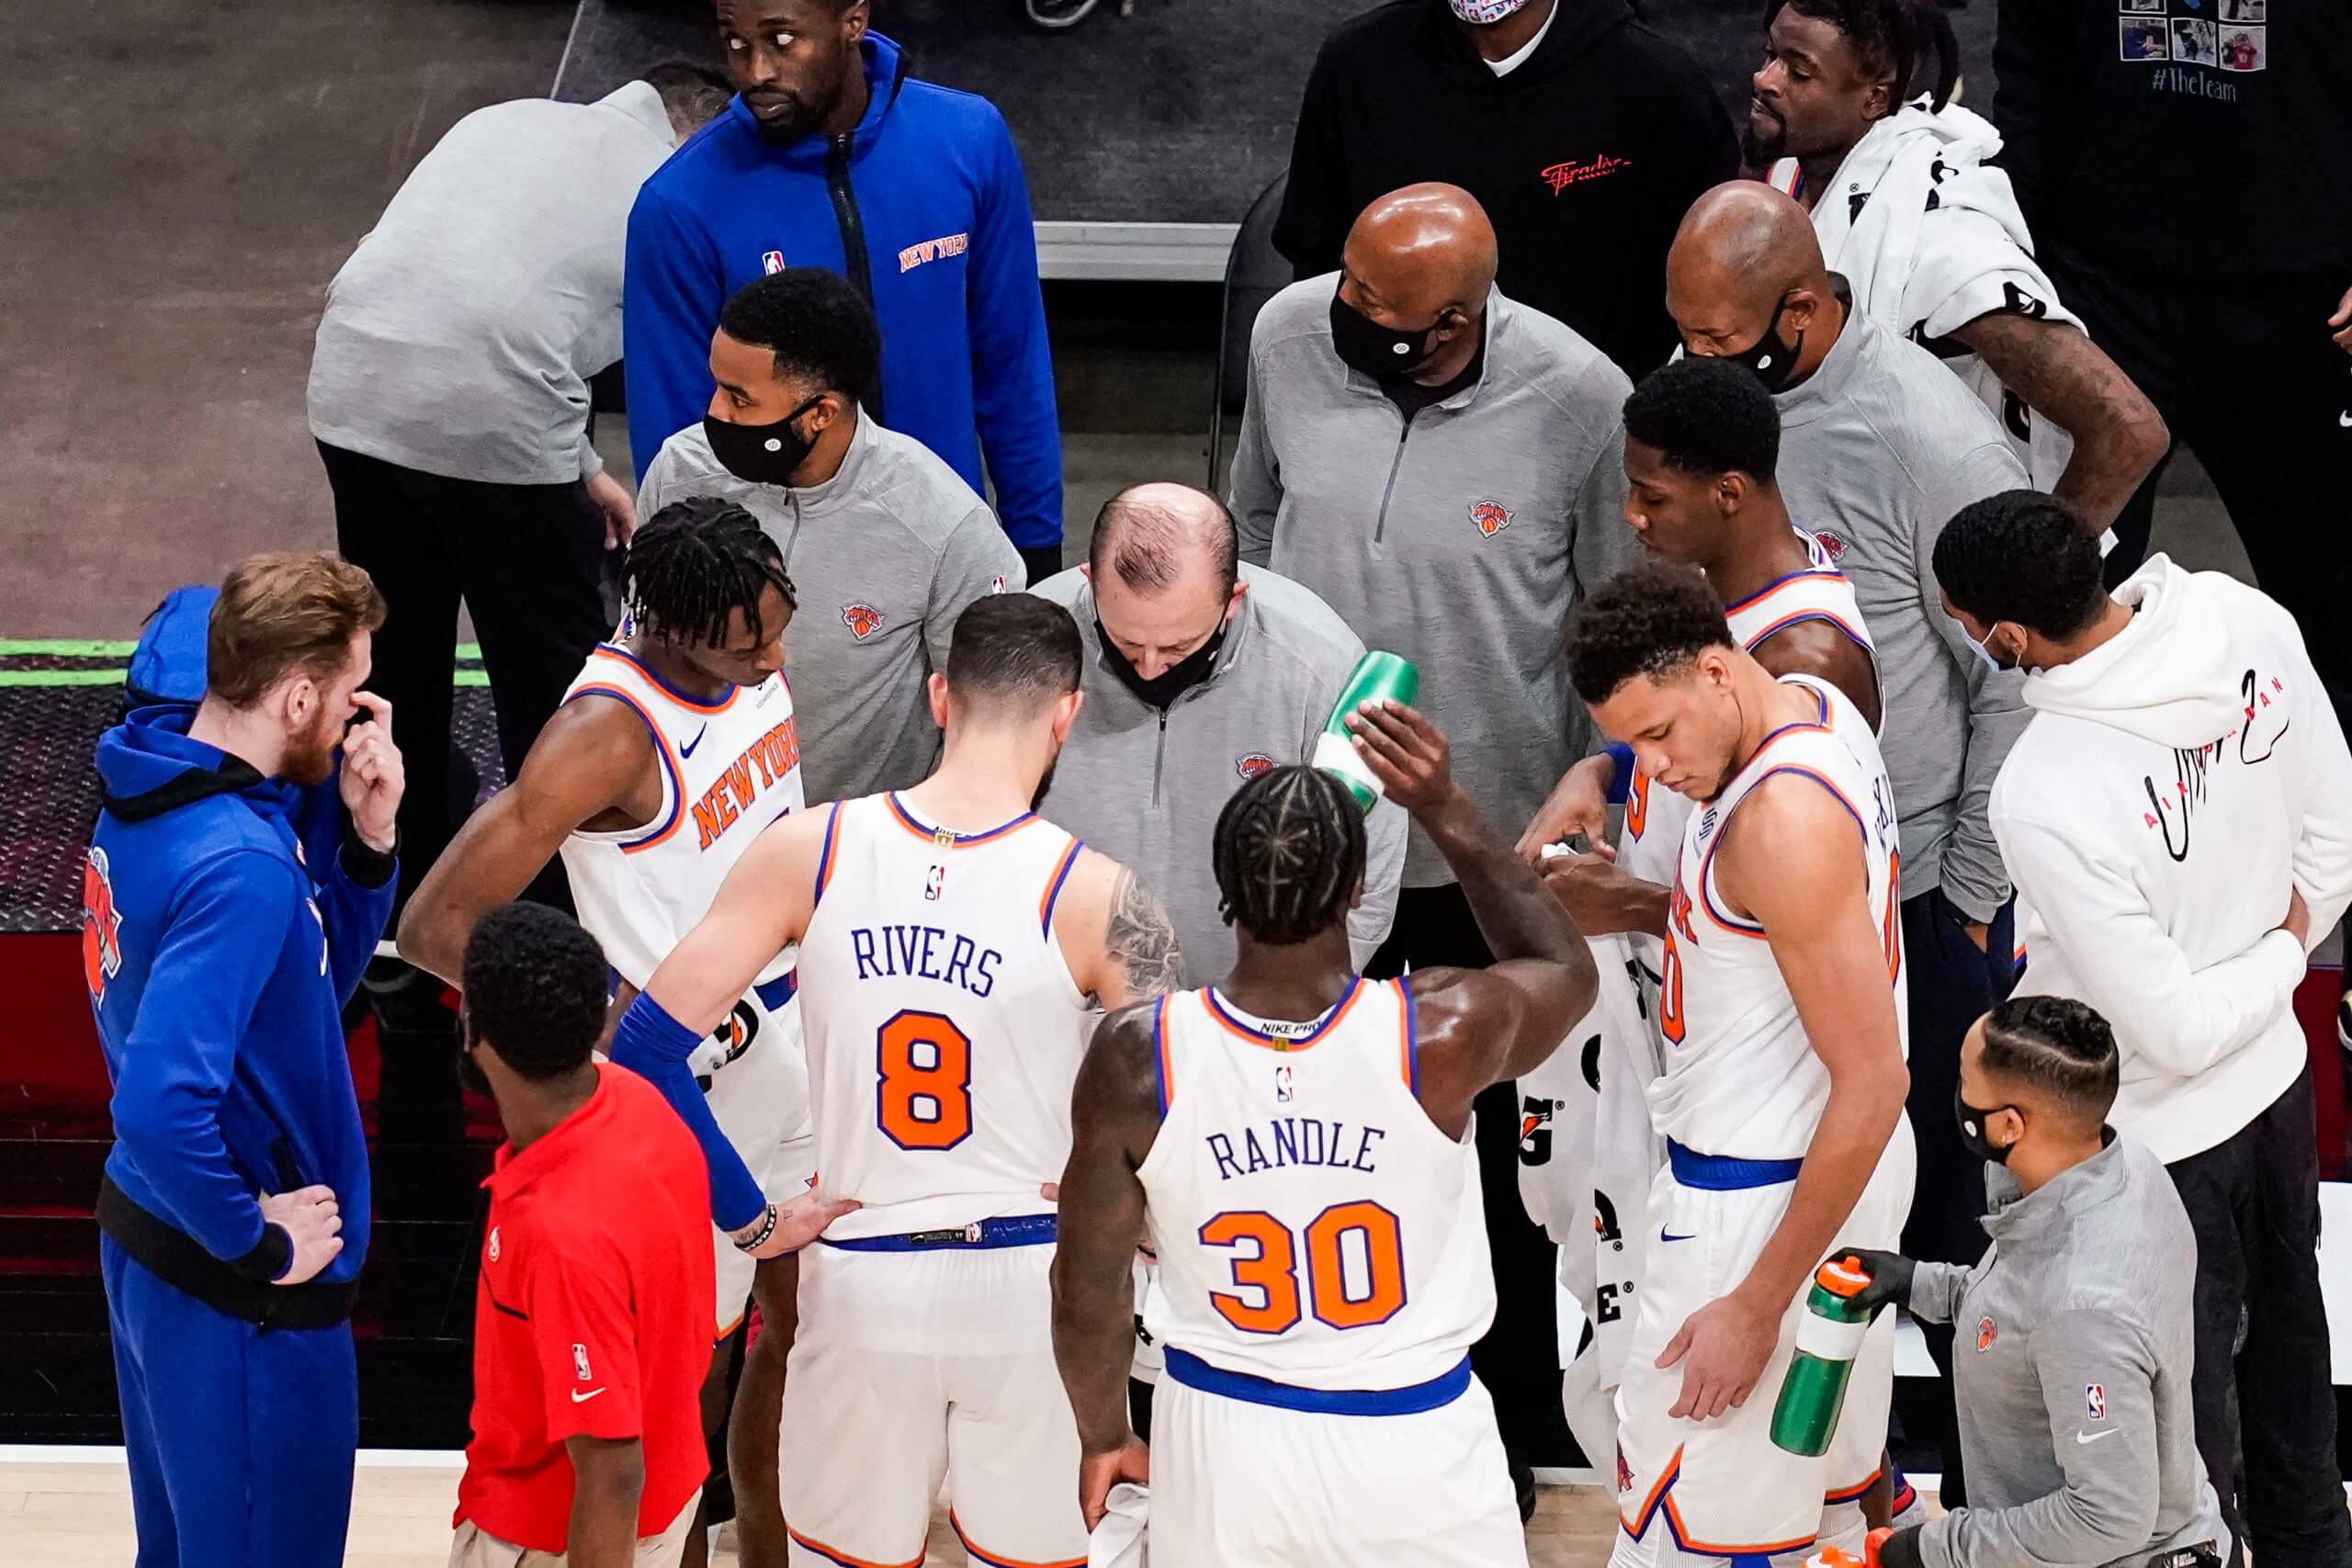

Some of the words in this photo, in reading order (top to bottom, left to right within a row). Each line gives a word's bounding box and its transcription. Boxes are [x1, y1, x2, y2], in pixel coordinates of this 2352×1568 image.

[2153, 67, 2236, 103] #TheTeam
[899, 241, 934, 274] NEW
[691, 753, 756, 852] NEW
[851, 925, 1002, 998] RIVERS
[1261, 1022, 1292, 1034] NIKE
[876, 1009, 974, 1151] 8
[1205, 1118, 1385, 1180] RANDLE
[1198, 1199, 1408, 1336] 30
